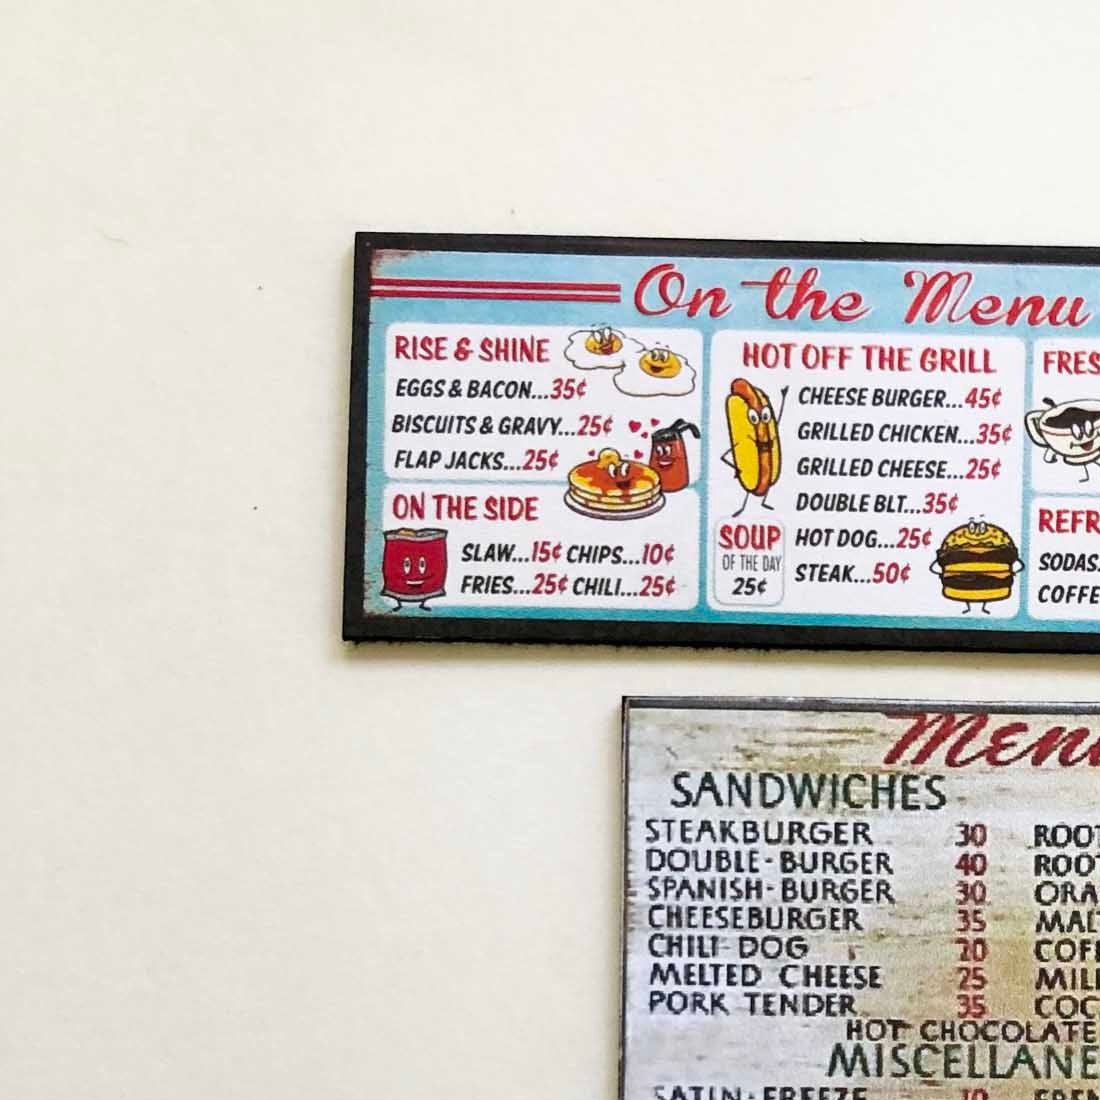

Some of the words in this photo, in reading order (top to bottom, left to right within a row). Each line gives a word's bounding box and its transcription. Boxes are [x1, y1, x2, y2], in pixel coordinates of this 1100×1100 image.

[634, 263, 732, 320] On
[741, 266, 870, 322] the
[904, 271, 1091, 328] Menu
[395, 336, 448, 361] RISE
[479, 336, 550, 363] SHINE
[743, 342, 797, 368] HOT
[802, 344, 850, 369] OFF
[862, 346, 912, 372] THE
[920, 347, 996, 374] GRILL
[396, 379, 446, 399] EGGS
[799, 387, 868, 406] CHEESE
[391, 415, 476, 434] BISCUITS
[798, 422, 874, 441] GRILLED
[394, 450, 441, 469] FLAP
[797, 458, 873, 477] GRILLED
[392, 493, 426, 519] ON
[433, 494, 476, 520] THE
[484, 496, 538, 521] SIDE
[719, 525, 781, 550] SOUP
[722, 554, 739, 571] OF
[743, 555, 759, 572] THE
[762, 555, 781, 572] DAY
[671, 772, 946, 810] SANDWICHES
[646, 820, 872, 847] STEAKBURGER
[955, 824, 987, 847] 30
[955, 852, 988, 876] 40
[648, 906, 863, 931] CHEESEBURGER
[649, 964, 762, 987] MELTED
[779, 964, 882, 990] CHEESE
[648, 993, 728, 1016] PORK
[744, 995, 856, 1017] TENDER
[920, 1019, 1096, 1043] CHOCOLATE
